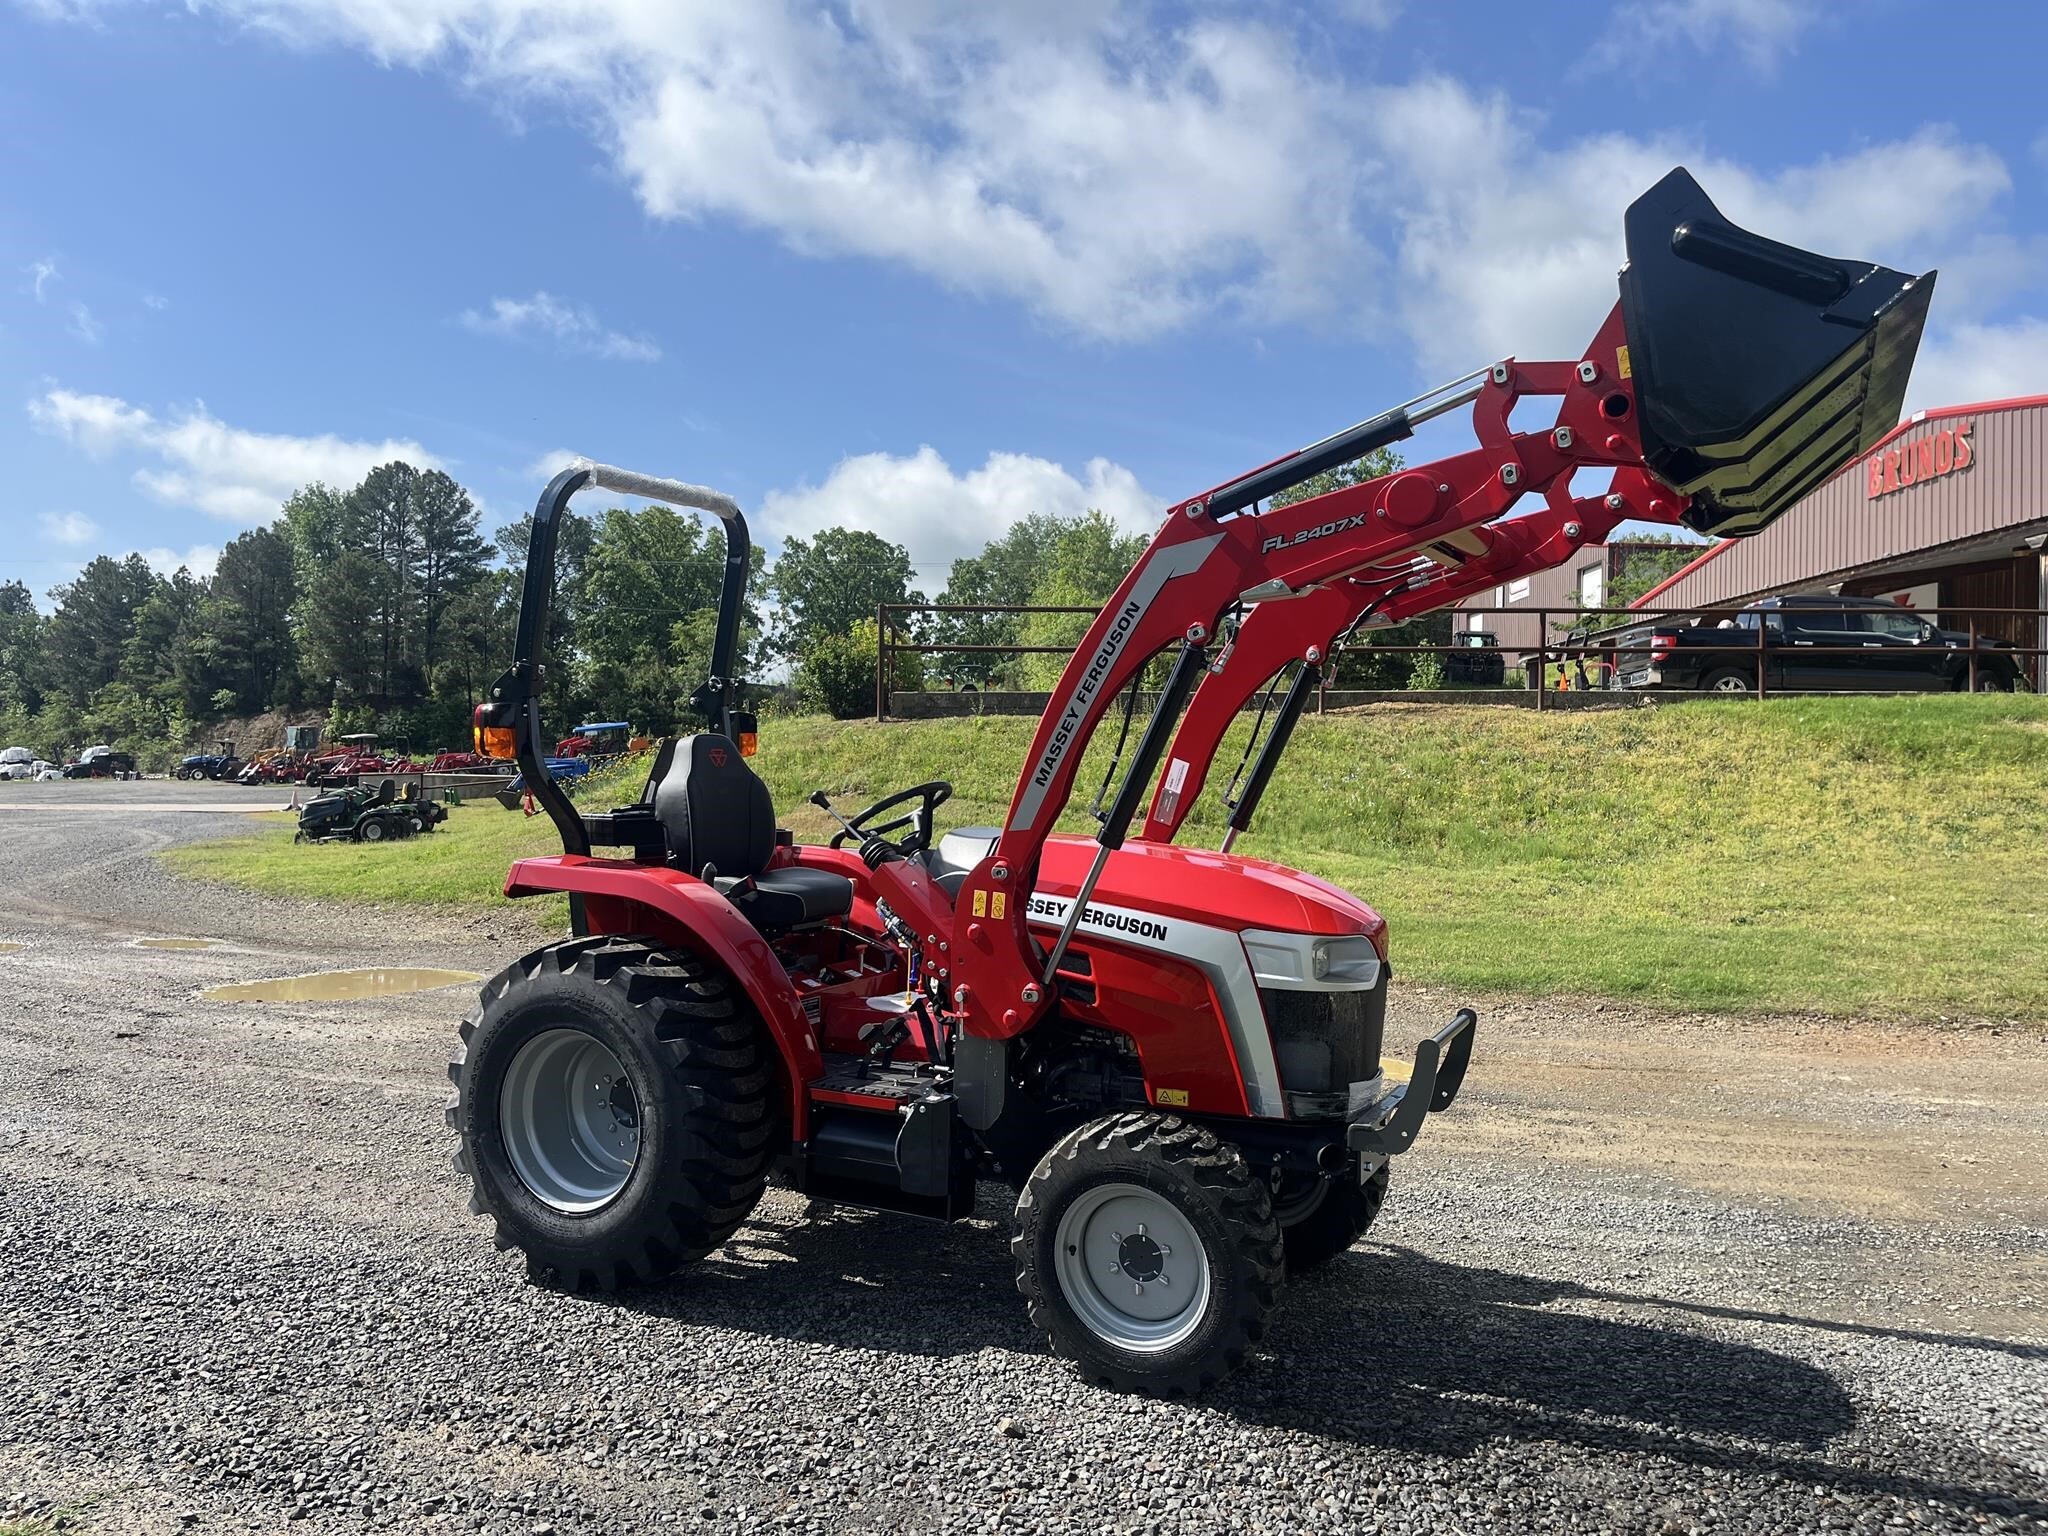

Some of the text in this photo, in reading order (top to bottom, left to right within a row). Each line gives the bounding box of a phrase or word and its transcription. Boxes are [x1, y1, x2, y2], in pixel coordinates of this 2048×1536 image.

[1868, 422, 1973, 500] BRUNOS
[1261, 512, 1367, 554] FL.2407X
[1035, 601, 1141, 787] MASSEY FERGUSON
[1026, 898, 1168, 941] SSEY ERGUSON
